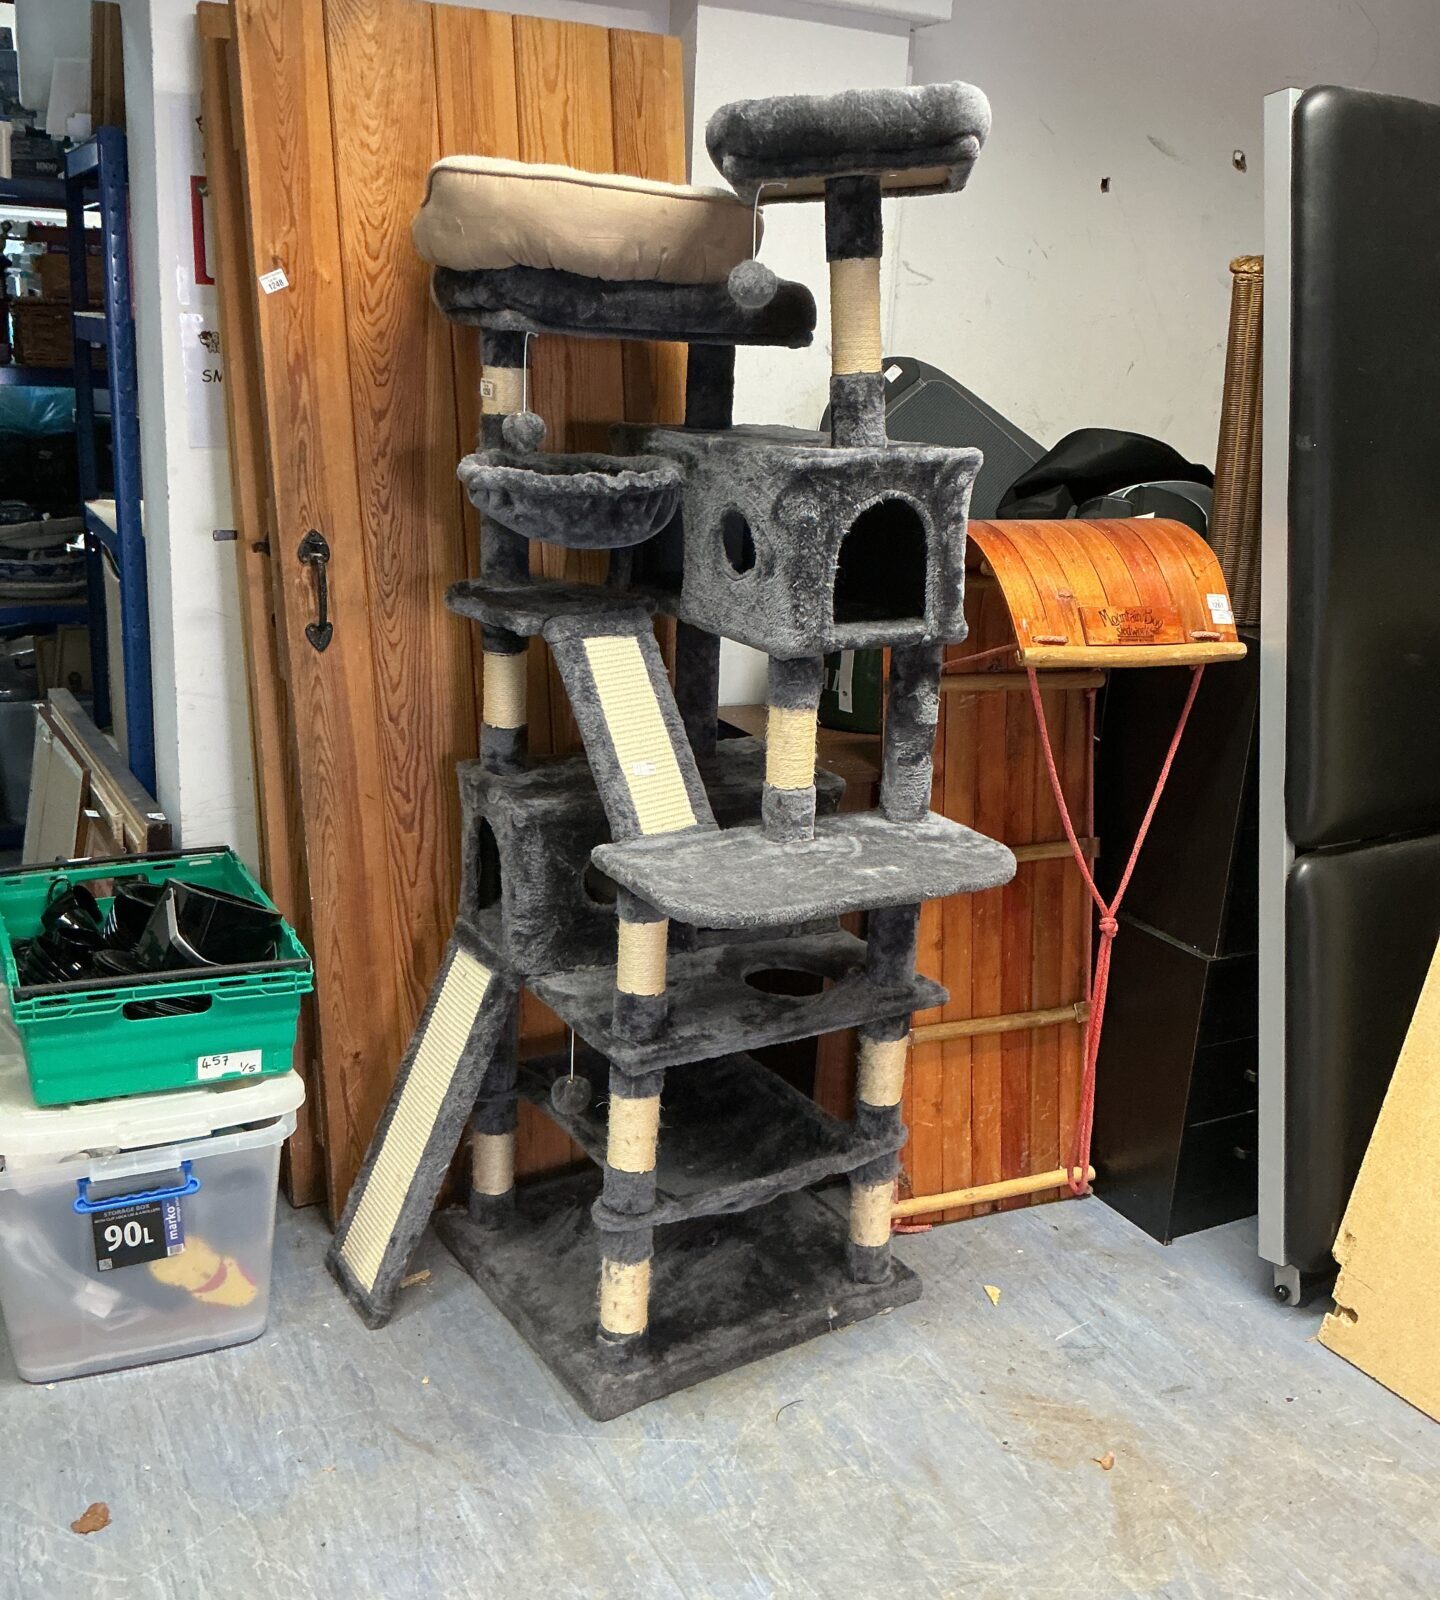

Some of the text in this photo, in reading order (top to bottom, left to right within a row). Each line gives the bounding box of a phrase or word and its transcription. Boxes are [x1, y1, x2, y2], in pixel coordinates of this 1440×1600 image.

[202, 1055, 229, 1069] 457
[103, 1203, 150, 1217] STORAGE BOX
[165, 1206, 179, 1240] marko
